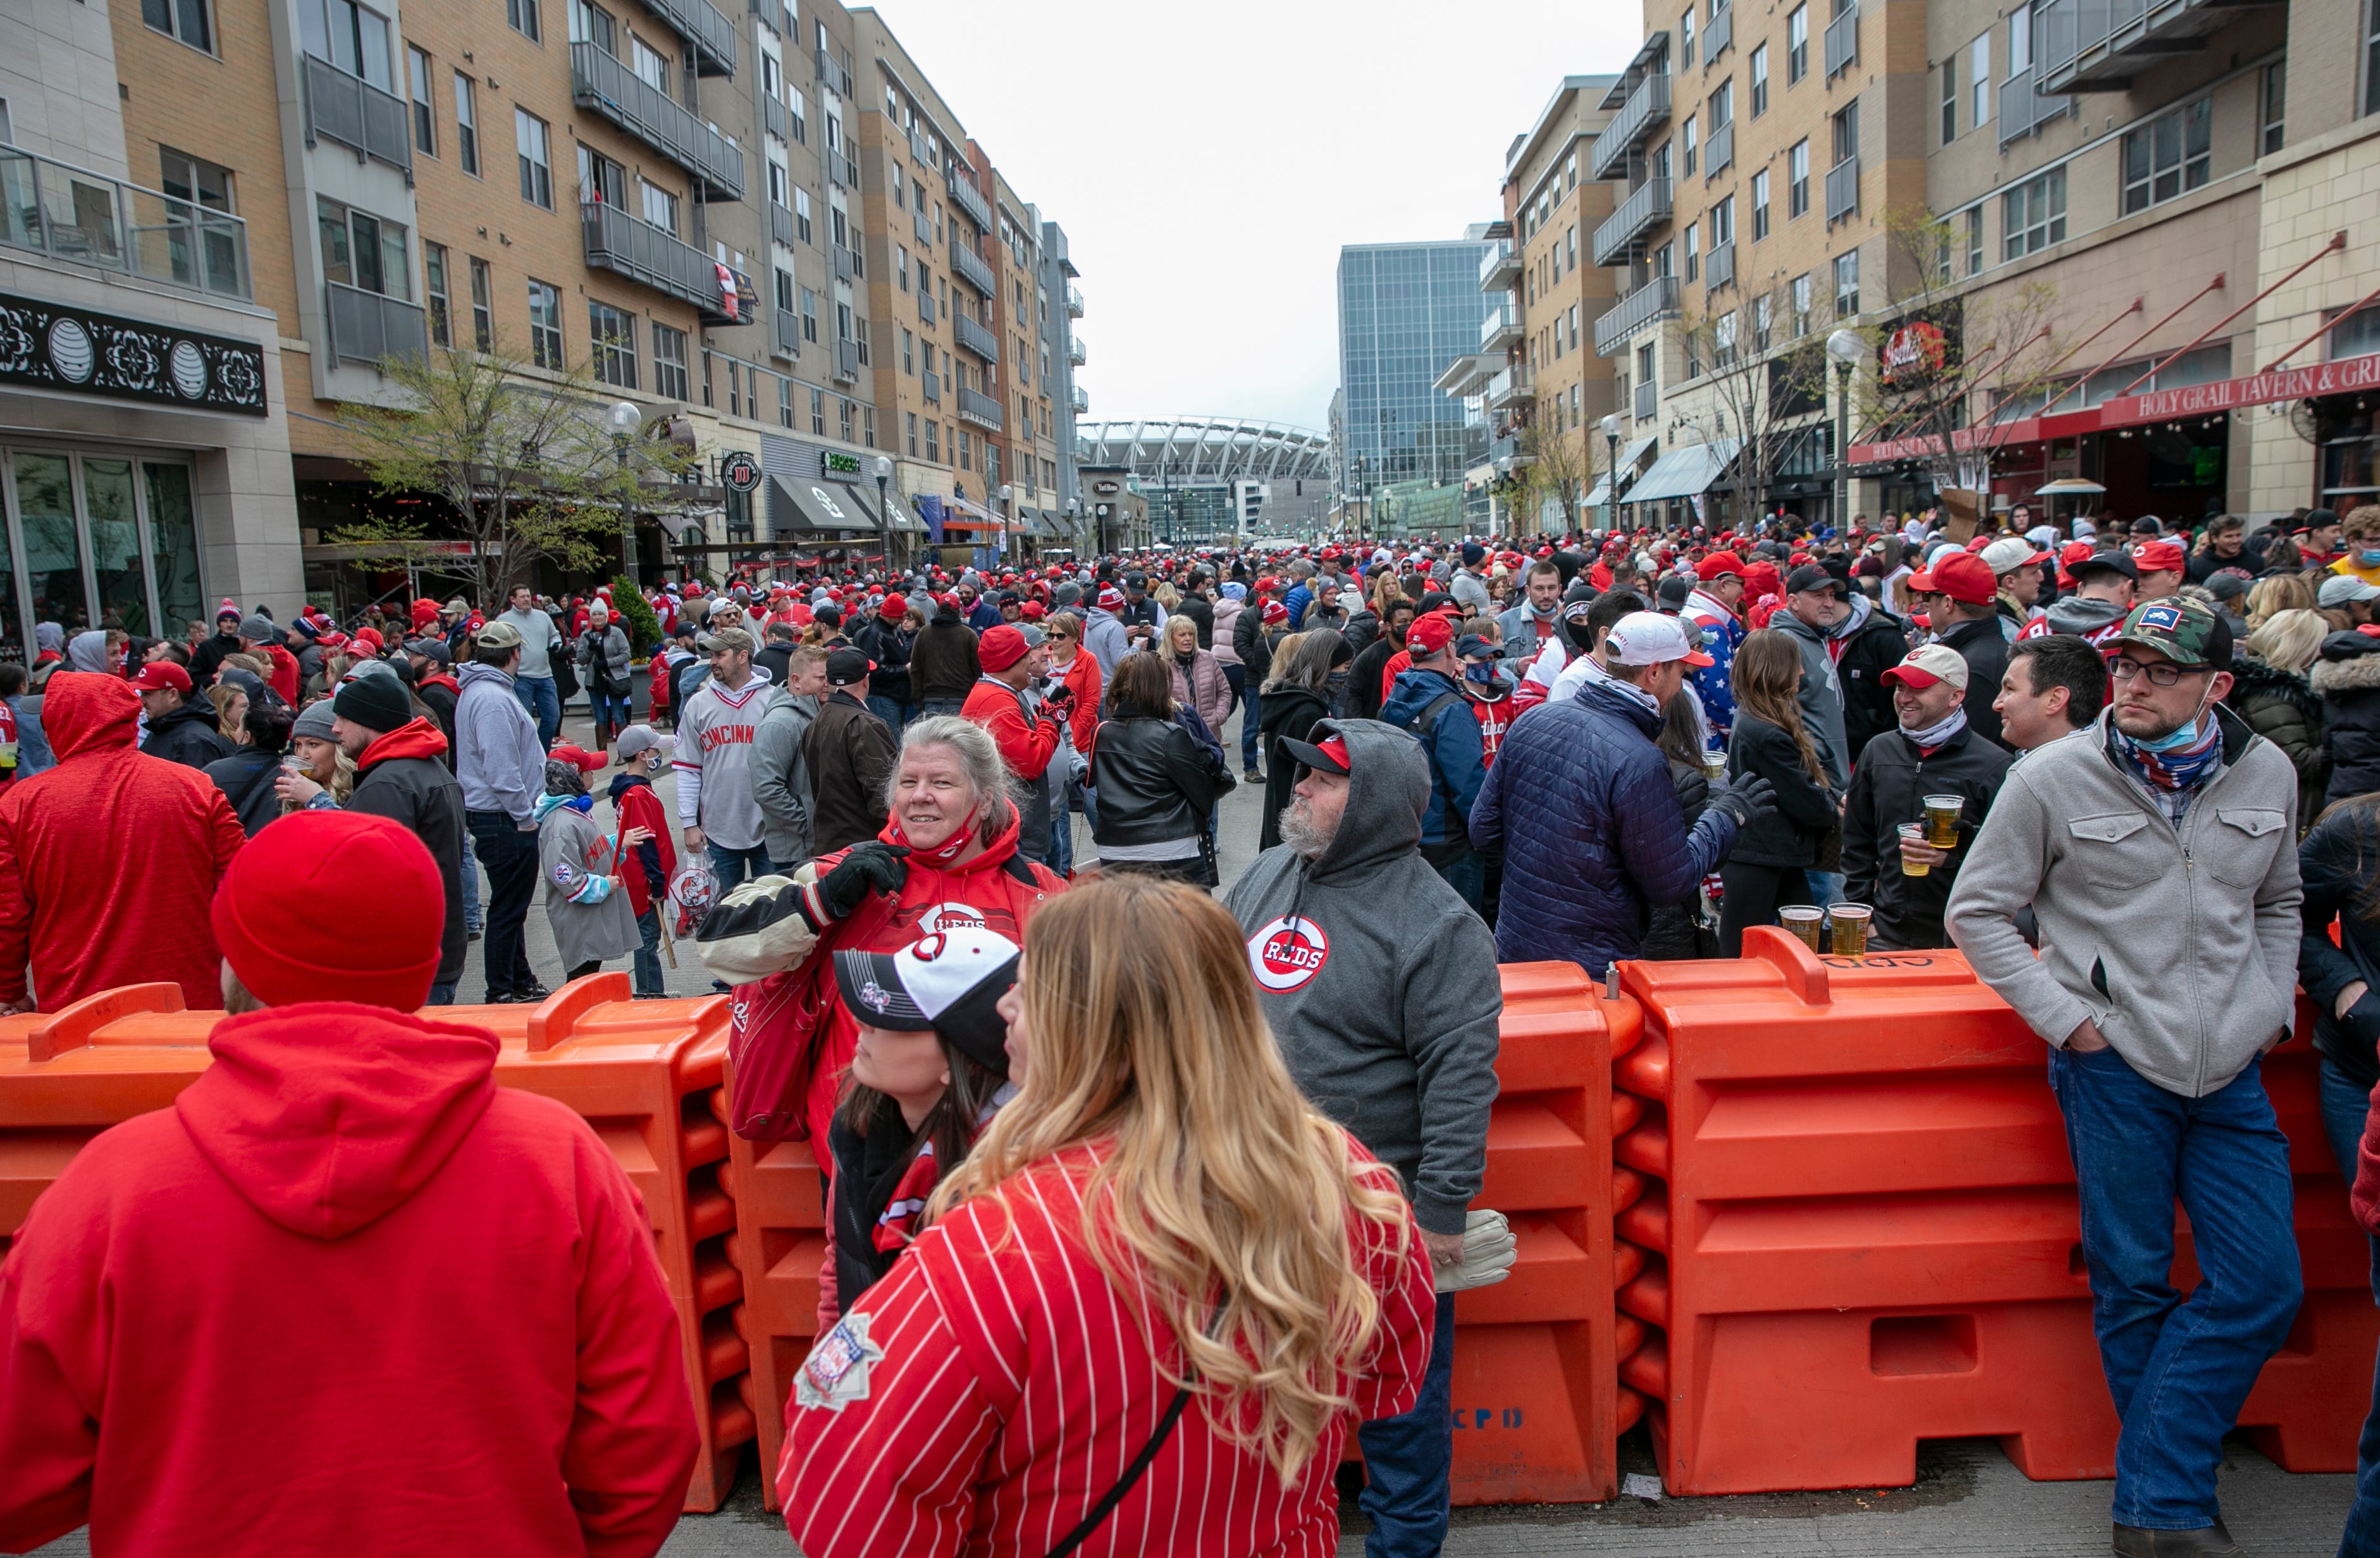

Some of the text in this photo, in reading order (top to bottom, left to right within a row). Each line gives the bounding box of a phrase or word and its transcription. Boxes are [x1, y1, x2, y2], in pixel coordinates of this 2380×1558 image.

[2139, 389, 2181, 417] HOLY
[2181, 381, 2235, 411] GRAIL
[2238, 368, 2314, 404] TAVERN
[2317, 364, 2336, 392] &
[1873, 443, 1891, 461] HOLY
[1917, 432, 1950, 455] TAVER
[734, 466, 749, 483] JJ
[700, 724, 755, 753] CINCINN
[1264, 941, 1324, 969] REDS
